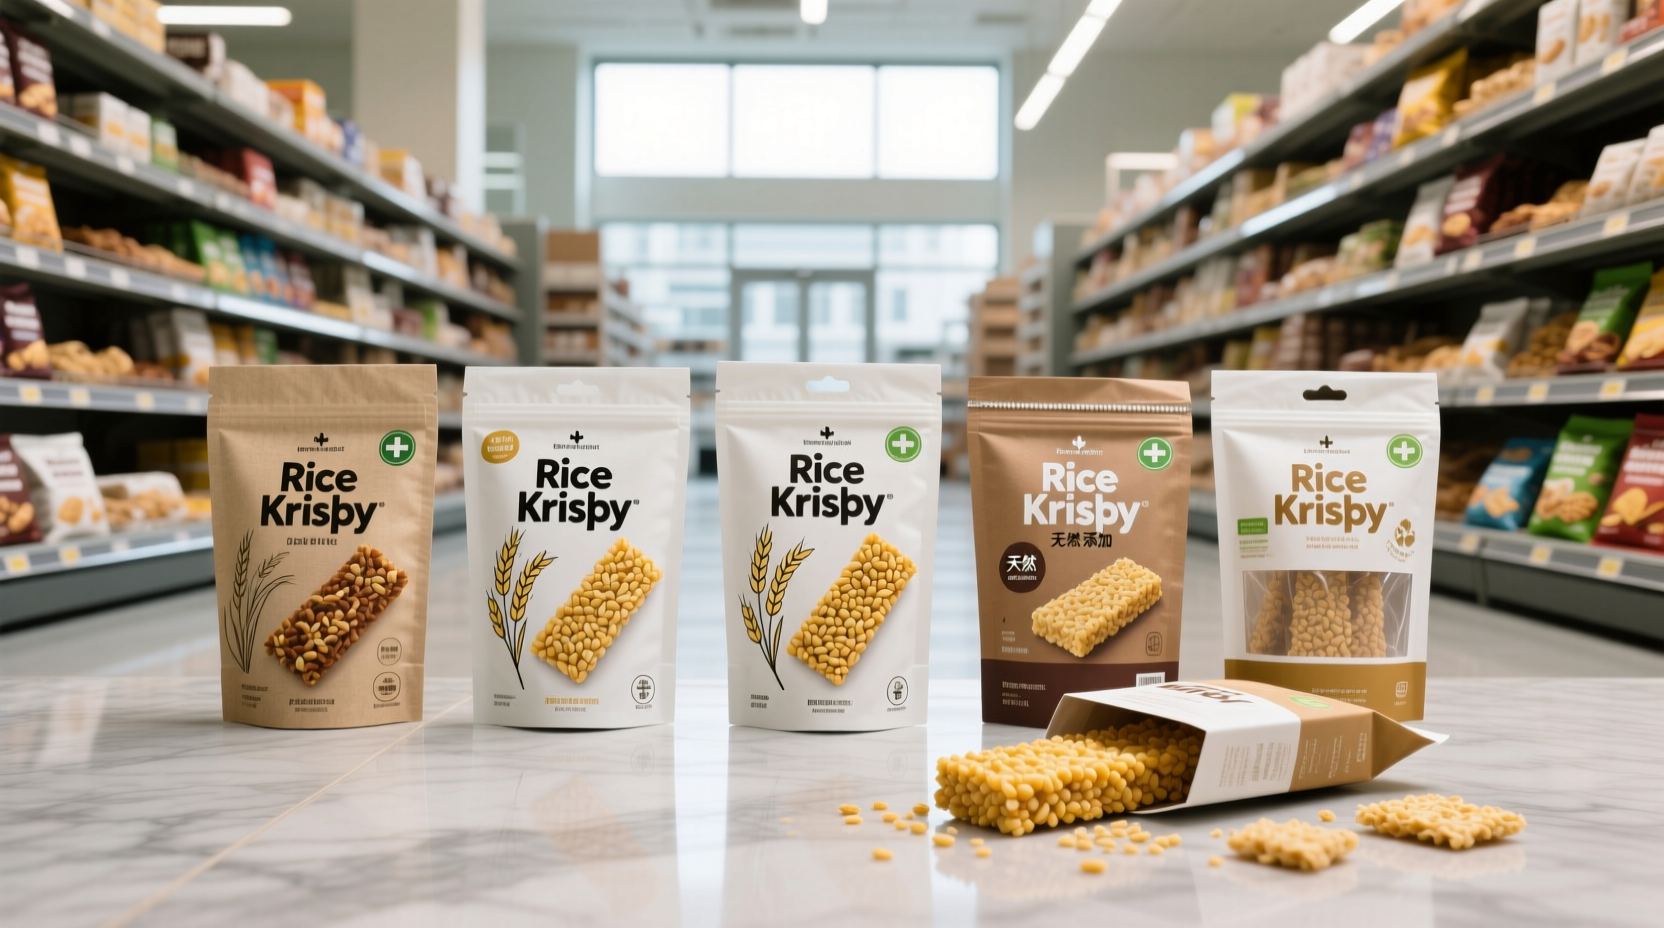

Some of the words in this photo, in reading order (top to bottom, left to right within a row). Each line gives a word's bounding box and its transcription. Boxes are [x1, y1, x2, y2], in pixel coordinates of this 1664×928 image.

[281, 461, 358, 493] Rice
[536, 457, 613, 489] Rice
[790, 453, 865, 485] Rice
[1040, 461, 1120, 494] Rice
[1291, 462, 1367, 494] Rice
[1006, 554, 1037, 573] 天然
